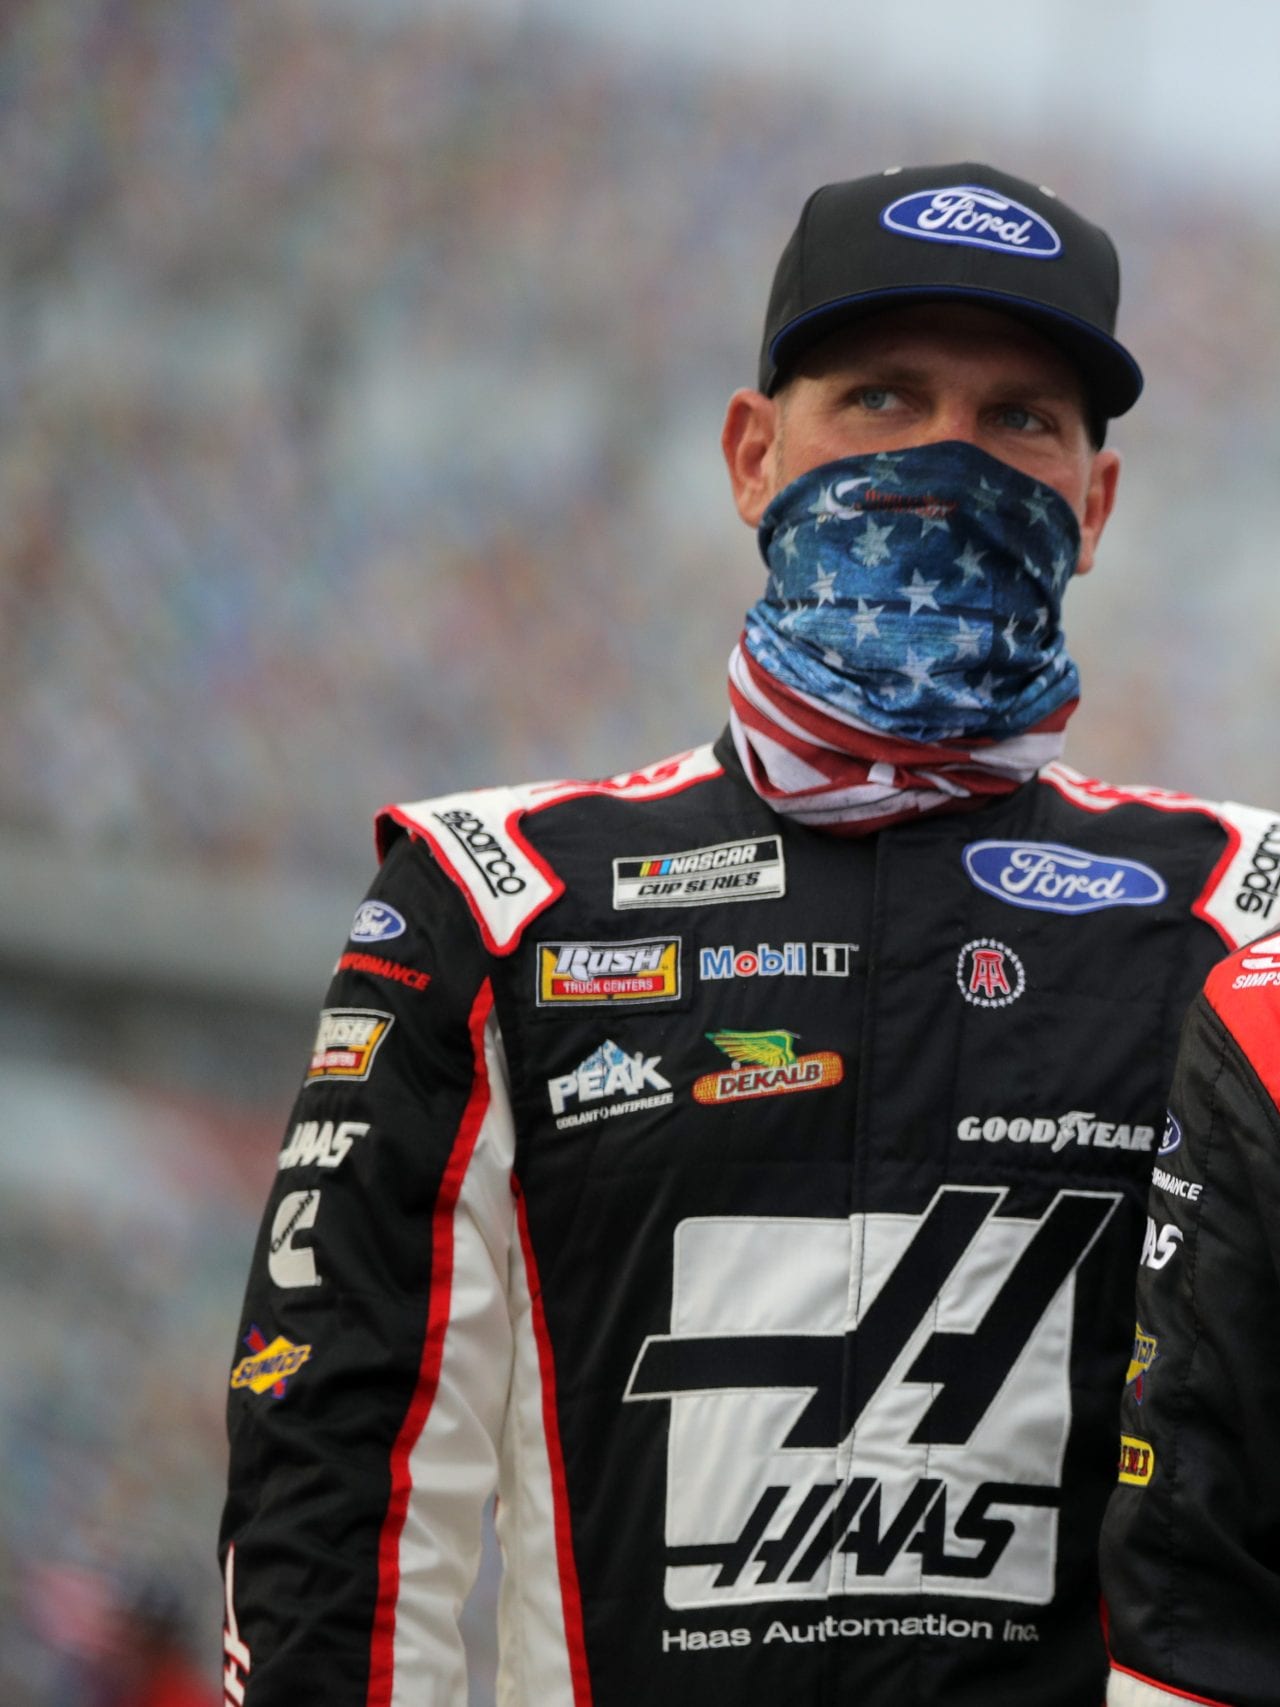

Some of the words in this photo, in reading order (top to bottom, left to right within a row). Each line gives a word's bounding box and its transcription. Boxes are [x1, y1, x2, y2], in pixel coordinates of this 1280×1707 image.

[917, 190, 1033, 245] Ford
[441, 808, 527, 896] sparco
[670, 844, 757, 875] NASCAR
[638, 882, 682, 896] CUP
[685, 872, 760, 894] SERIES
[1000, 849, 1125, 901] Ford
[700, 942, 807, 980] Mobil
[563, 981, 601, 994] TRUCK
[604, 978, 653, 992] CENTERS
[548, 1052, 672, 1115] PEAK
[717, 1062, 822, 1100] DEKALB
[556, 1108, 600, 1130] COOLANT
[609, 1092, 674, 1117] ANTIFREEZE
[957, 1114, 1155, 1152] GOODYEAR
[665, 1477, 1062, 1588] HAAS
[662, 1627, 751, 1653] Haas
[763, 1614, 993, 1644] Automation
[1004, 1619, 1040, 1642] Inc.
